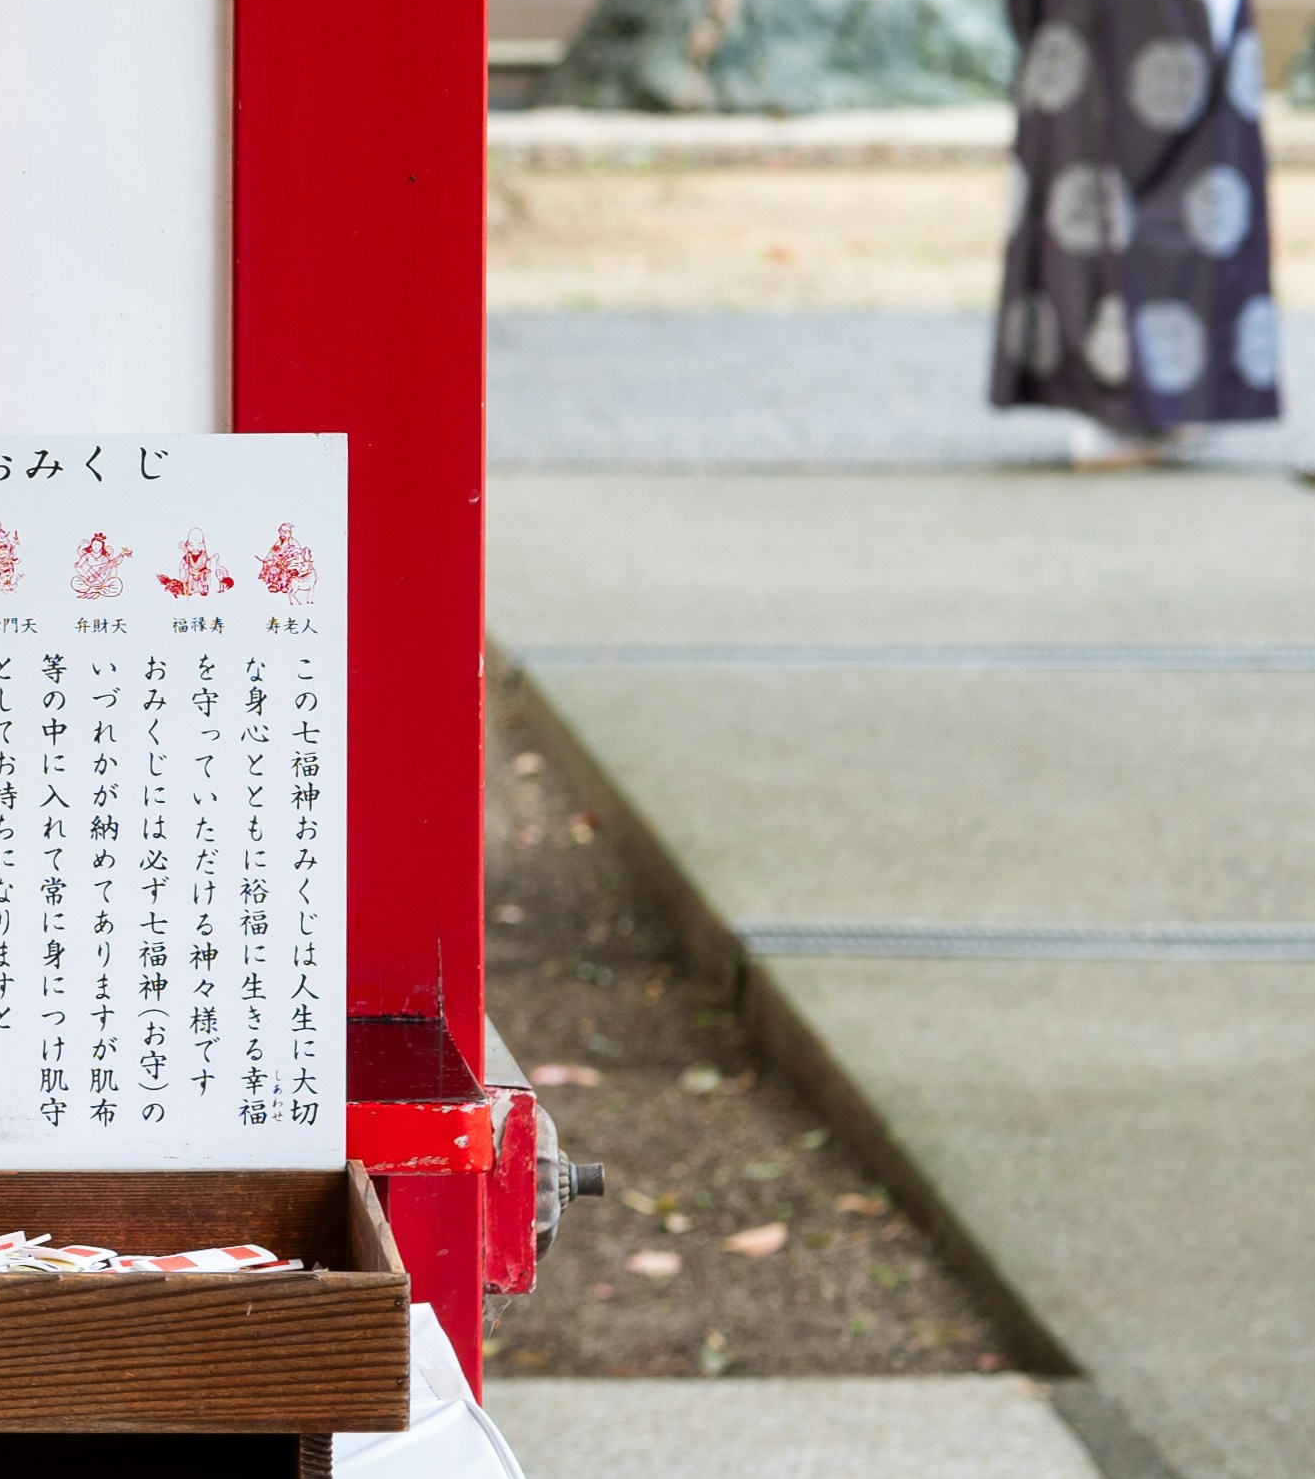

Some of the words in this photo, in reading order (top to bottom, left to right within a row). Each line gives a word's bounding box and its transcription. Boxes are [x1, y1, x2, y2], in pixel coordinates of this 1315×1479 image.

[76, 617, 127, 634] 弁財天
[172, 616, 224, 635] 福禄寿
[267, 616, 317, 635] 寿老人
[40, 653, 70, 1128] 等の中に入れて常に身につけ肌守
[90, 663, 121, 1128] いづれかが納めてありますが肌布
[189, 653, 221, 1096] を守っていただける神々様です
[238, 657, 269, 1126] な身心とともに裕福に生きる幸福
[290, 659, 321, 1126] この七福神おみくじは人生に大切
[272, 1070, 284, 1123] しあわせ
